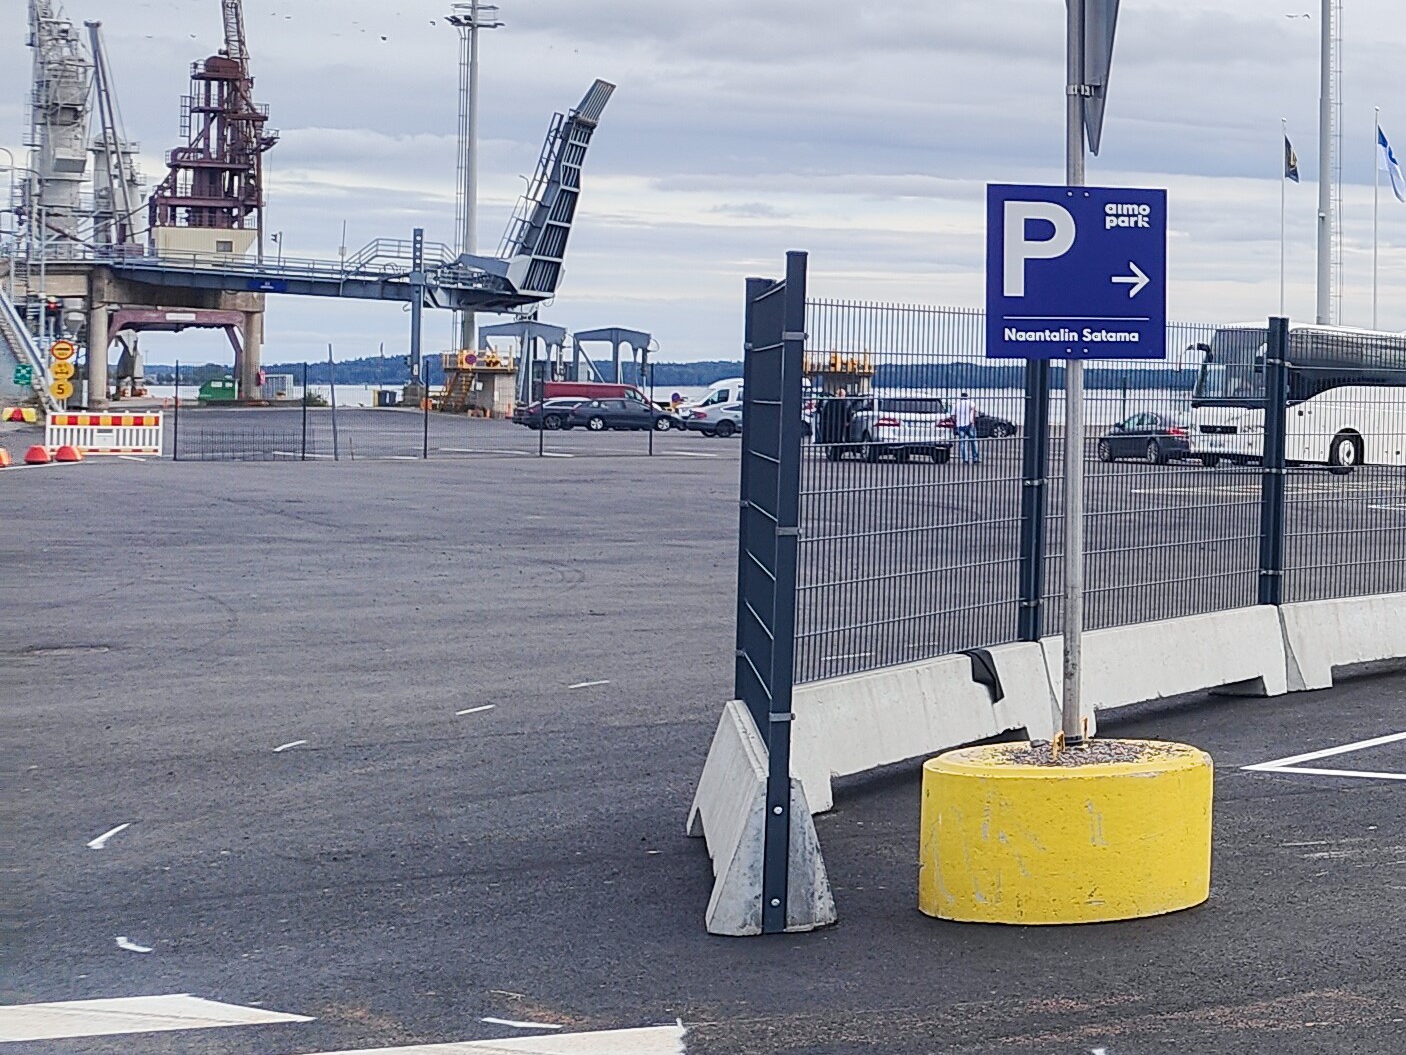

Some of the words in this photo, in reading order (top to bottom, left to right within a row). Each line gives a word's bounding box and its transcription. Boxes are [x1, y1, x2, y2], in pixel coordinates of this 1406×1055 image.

[1105, 203, 1150, 215] aimo
[1105, 215, 1150, 229] park
[1003, 200, 1076, 297] P
[1004, 327, 1079, 342] Naantalin
[1082, 327, 1140, 342] Satama
[56, 384, 66, 395] 5
